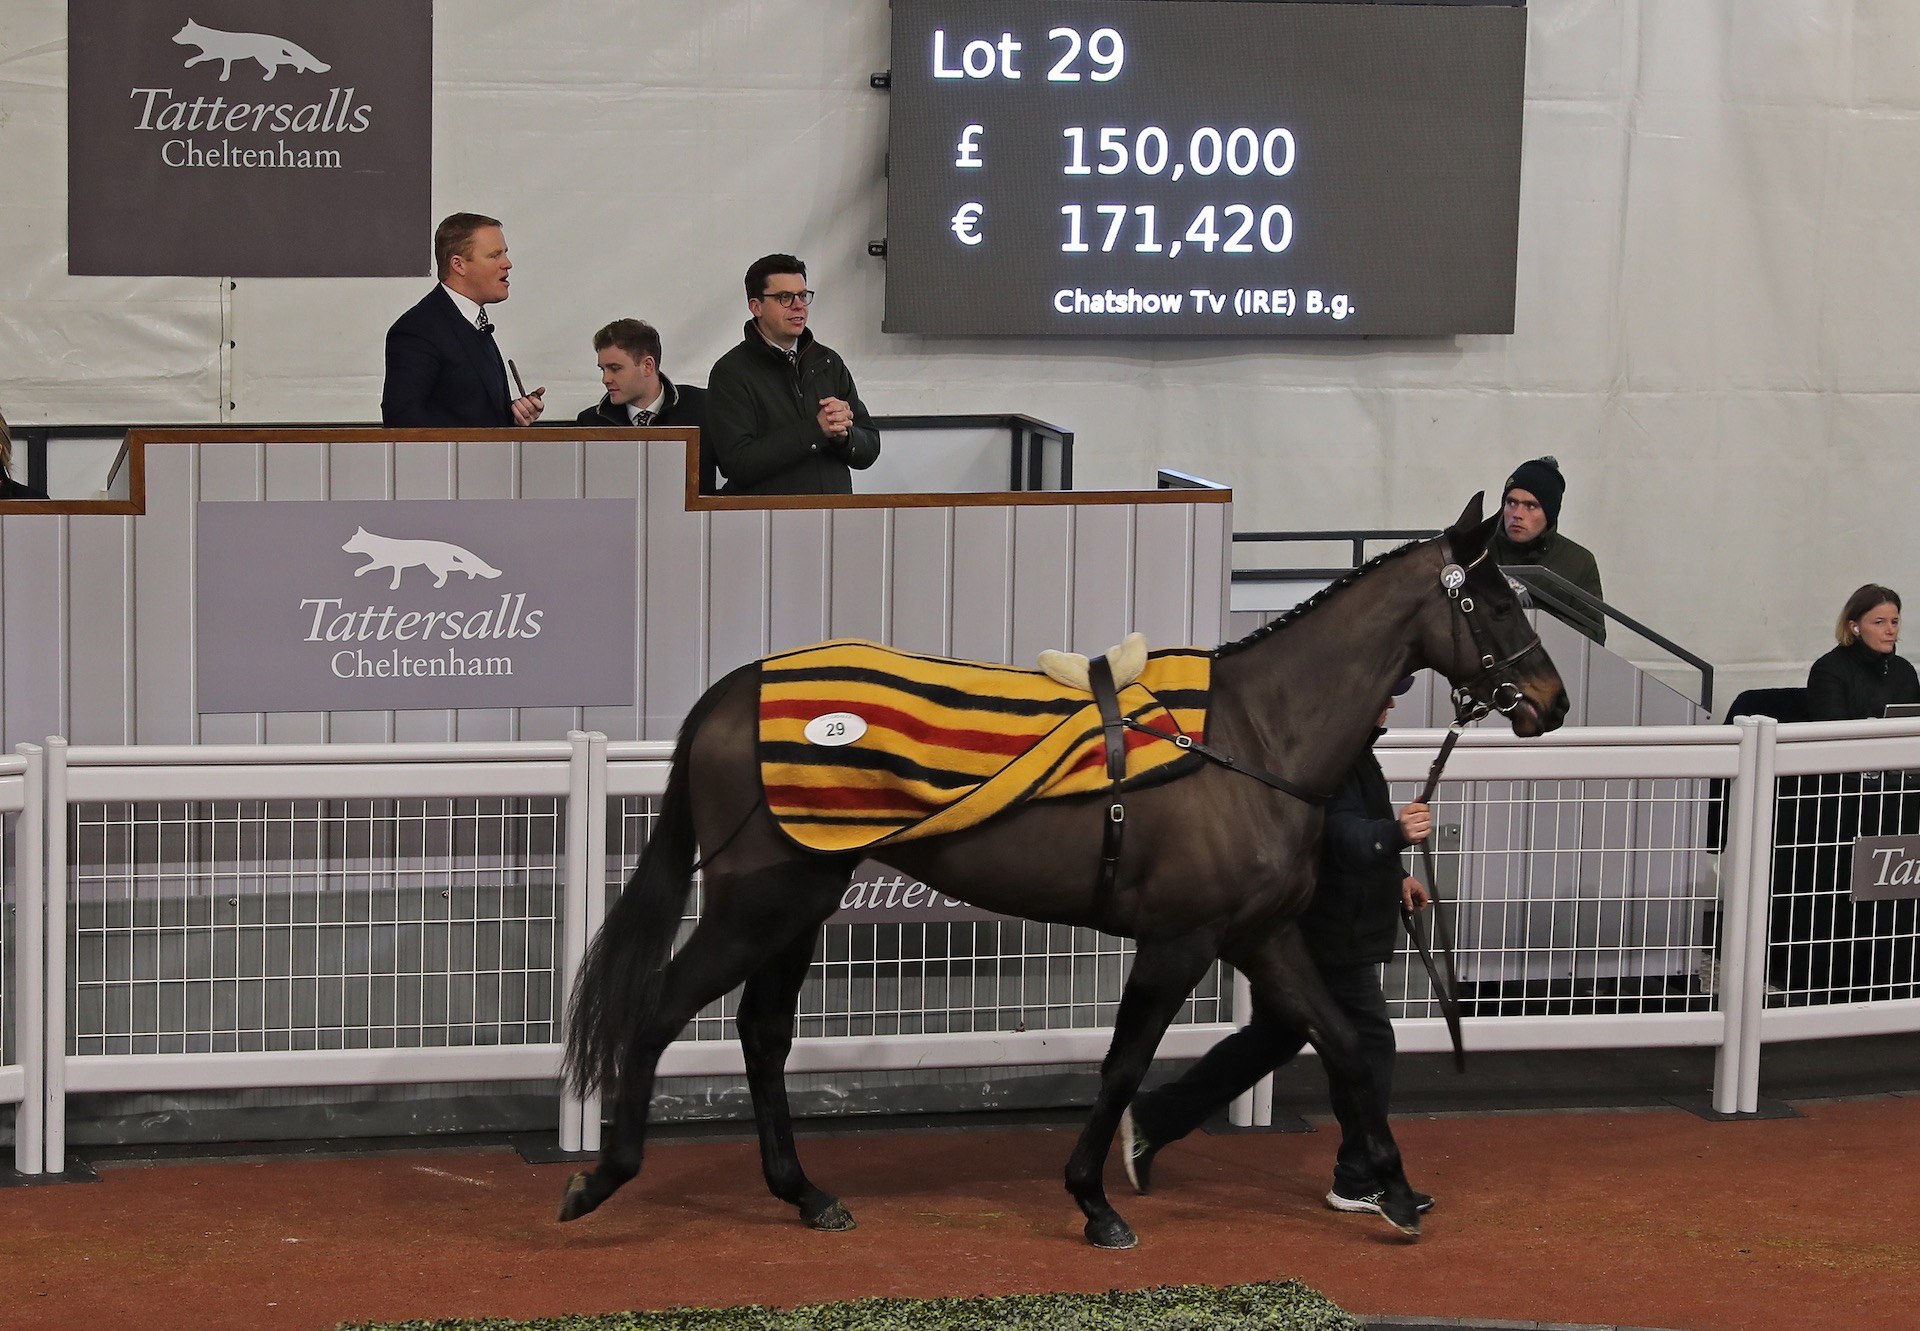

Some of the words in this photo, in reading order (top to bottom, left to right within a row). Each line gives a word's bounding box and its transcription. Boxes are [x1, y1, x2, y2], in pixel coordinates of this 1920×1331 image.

[933, 30, 1022, 79] Lot
[1047, 28, 1124, 82] 29
[130, 87, 372, 133] Tattersalls
[161, 138, 342, 168] Cheltenham
[955, 124, 984, 168] £
[1062, 126, 1296, 182] 150,000
[951, 202, 983, 245] €
[1060, 204, 1294, 259] 171,420
[1054, 288, 1183, 314] Chatshow
[1189, 290, 1227, 314] Tv
[1234, 288, 1297, 317] (IRE)
[1306, 289, 1356, 320] B.g.
[1446, 570, 1463, 588] 29
[299, 592, 544, 643] Tattersalls
[331, 647, 514, 679] Cheltenham
[826, 722, 845, 736] 29
